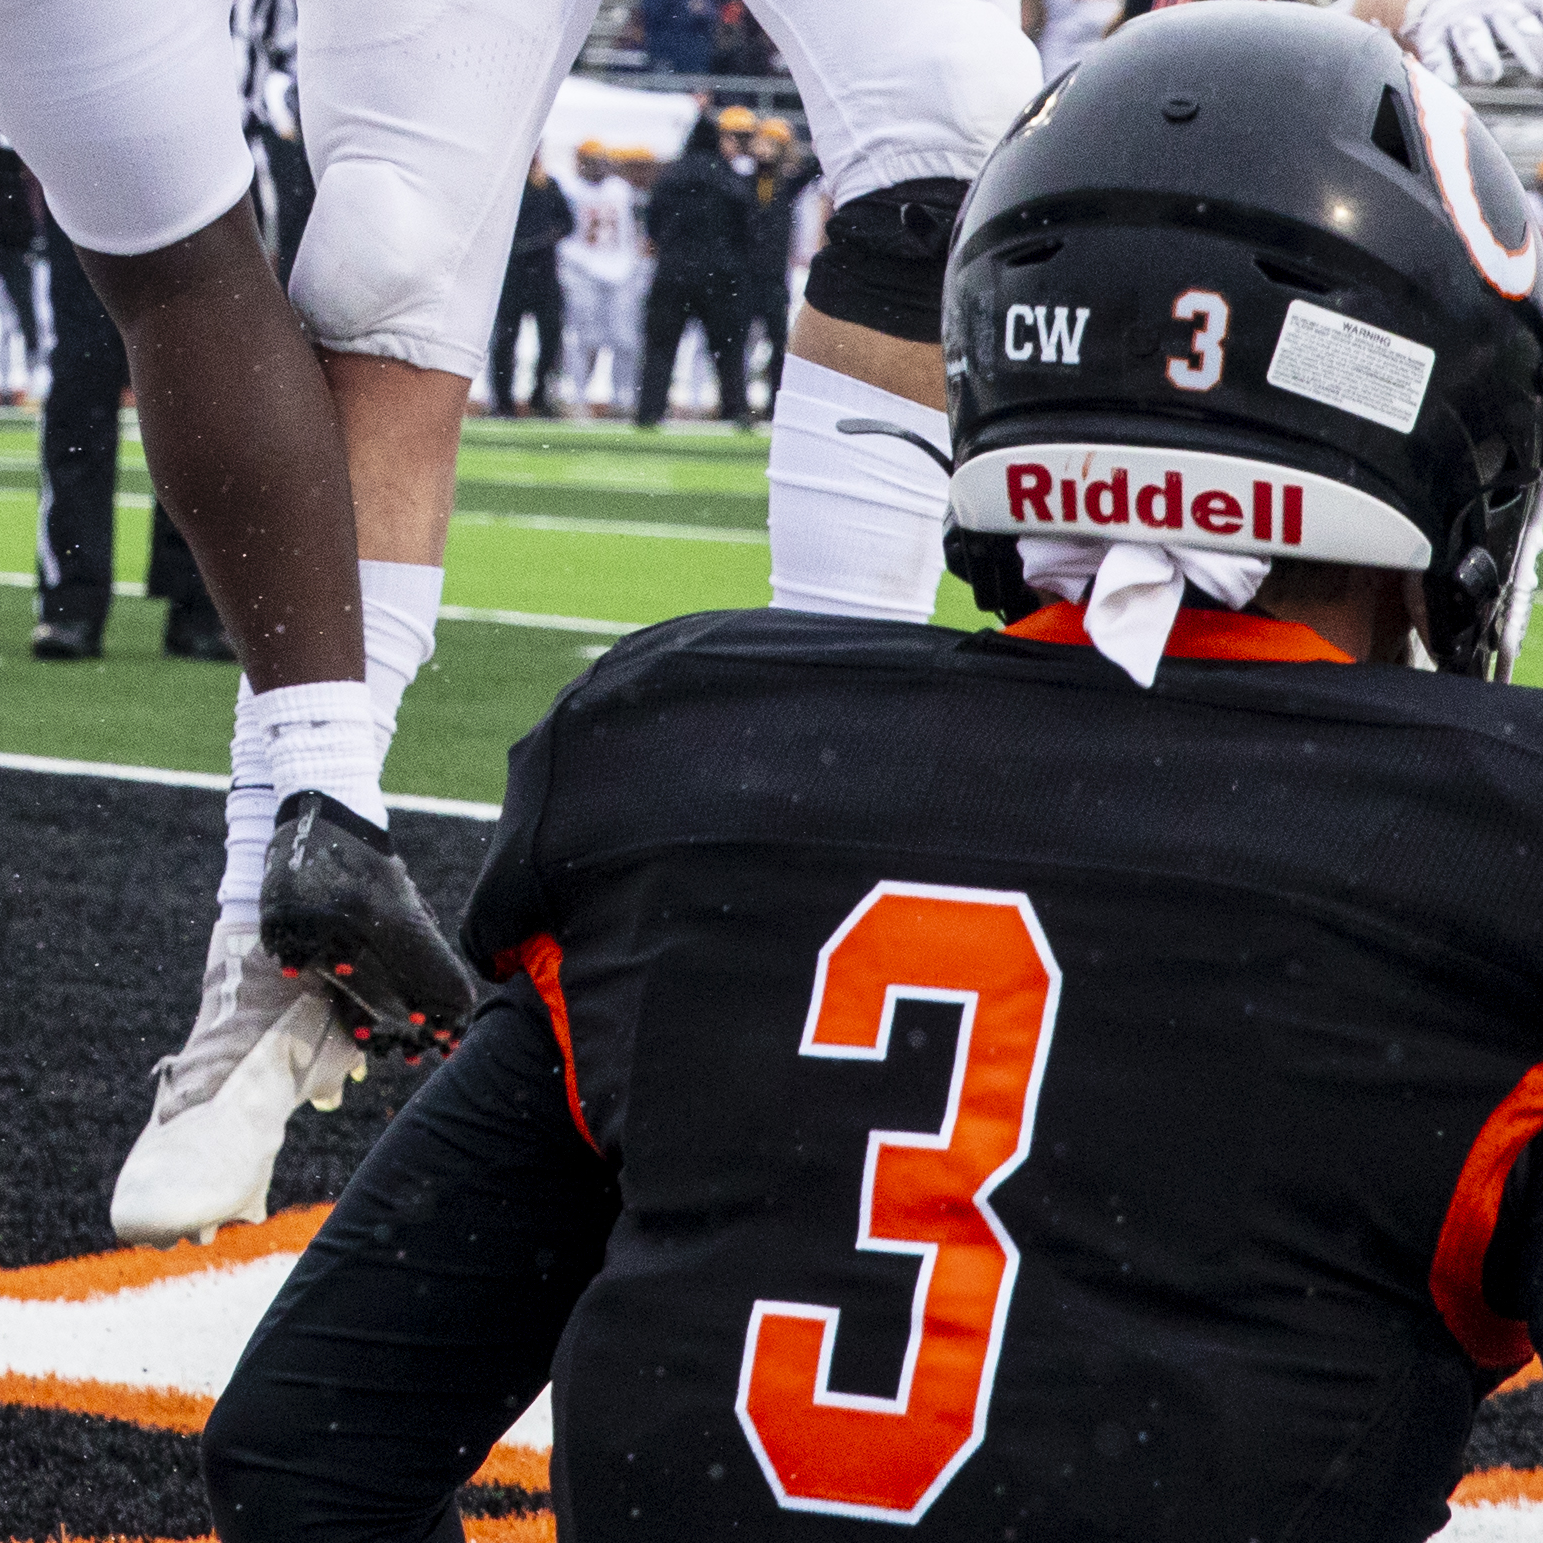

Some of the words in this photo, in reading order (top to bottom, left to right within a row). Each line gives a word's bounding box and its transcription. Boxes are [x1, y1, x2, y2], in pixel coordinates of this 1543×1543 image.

[1004, 303, 1090, 365] CW
[1164, 287, 1231, 393] 3
[1004, 462, 1303, 547] Riddell
[733, 879, 1062, 1526] 3
